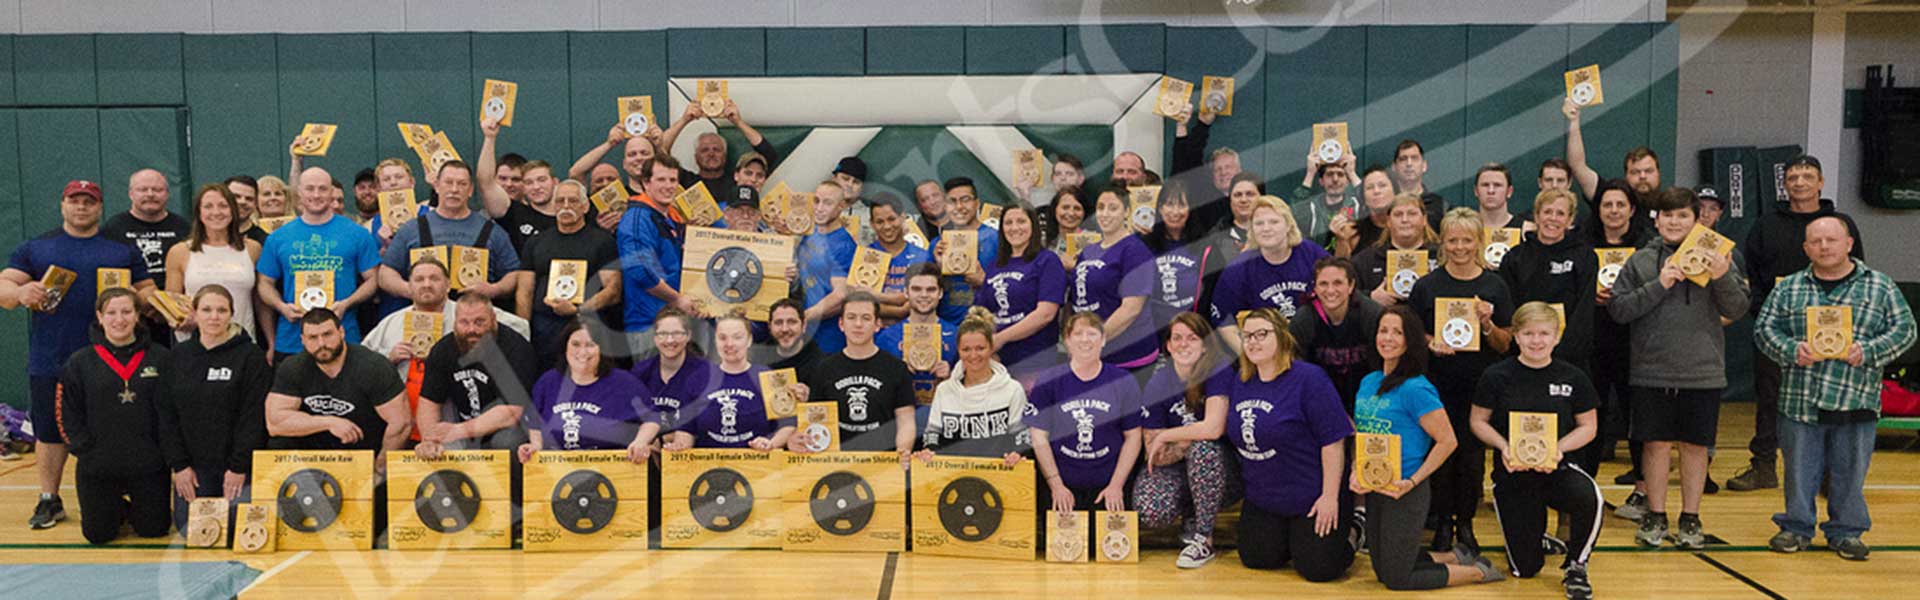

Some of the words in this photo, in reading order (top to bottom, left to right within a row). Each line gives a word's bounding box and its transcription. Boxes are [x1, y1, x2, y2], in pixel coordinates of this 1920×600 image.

[712, 232, 734, 240] Overall
[1287, 281, 1308, 292] PACK
[834, 376, 863, 390] GORILLA
[864, 376, 883, 390] PACK
[552, 402, 582, 414] GORILLA
[582, 402, 602, 415] PACK
[1060, 399, 1090, 413] GORILLA
[1090, 399, 1111, 413] PACK
[943, 410, 1008, 439] PINK
[274, 455, 292, 463] 2017
[292, 455, 318, 463] Overall
[319, 455, 336, 463] Male
[338, 455, 353, 463] Raw
[402, 454, 420, 463] 2017
[448, 454, 466, 462] Male
[466, 454, 494, 462] Shirted
[538, 455, 557, 463] 2017
[558, 455, 584, 463] Overall
[584, 455, 610, 463] Female
[671, 453, 688, 462] 2017
[689, 453, 714, 462] Overall
[715, 452, 742, 461] Female
[743, 452, 770, 461] Shirted
[787, 455, 806, 464] 2017
[806, 456, 833, 464] Overall
[834, 456, 851, 464] Male
[852, 456, 872, 464] Team
[872, 456, 900, 464] Shirted
[926, 461, 944, 470] 2017
[944, 462, 970, 470] Overall
[970, 463, 998, 471] Female
